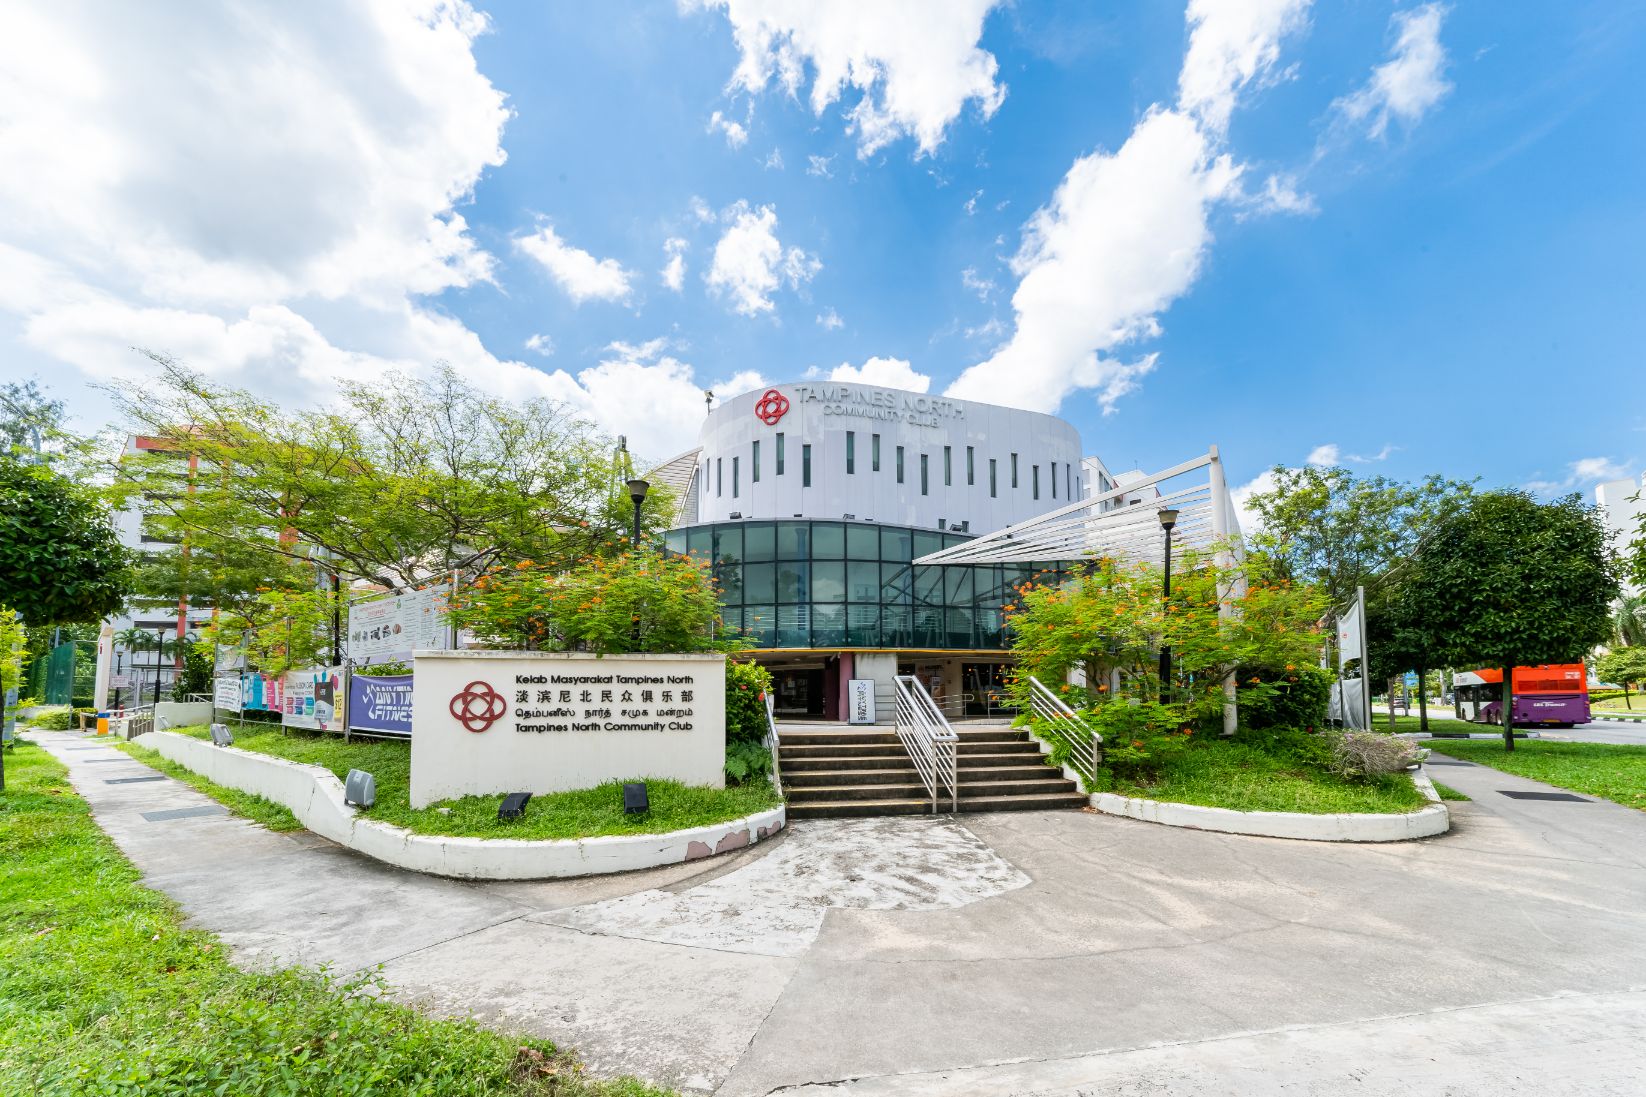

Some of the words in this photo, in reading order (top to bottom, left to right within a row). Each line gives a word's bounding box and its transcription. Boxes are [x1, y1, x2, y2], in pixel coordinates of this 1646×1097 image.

[795, 386, 895, 410] TAMPINES
[901, 393, 965, 420] NORTH
[823, 404, 905, 423] COMMUNITY
[906, 413, 939, 428] CLUB
[515, 674, 547, 684] Kelab
[550, 674, 613, 686] Masyarakat
[615, 674, 664, 685] Tampines
[667, 675, 694, 684] North
[375, 685, 412, 705] ANYTIM
[515, 689, 694, 704] 淡滨尼北民众俱乐部
[374, 705, 412, 722] FITNES
[515, 722, 568, 733] Tampines
[571, 722, 600, 732] North
[603, 721, 666, 732] Community
[668, 721, 693, 731] Club
